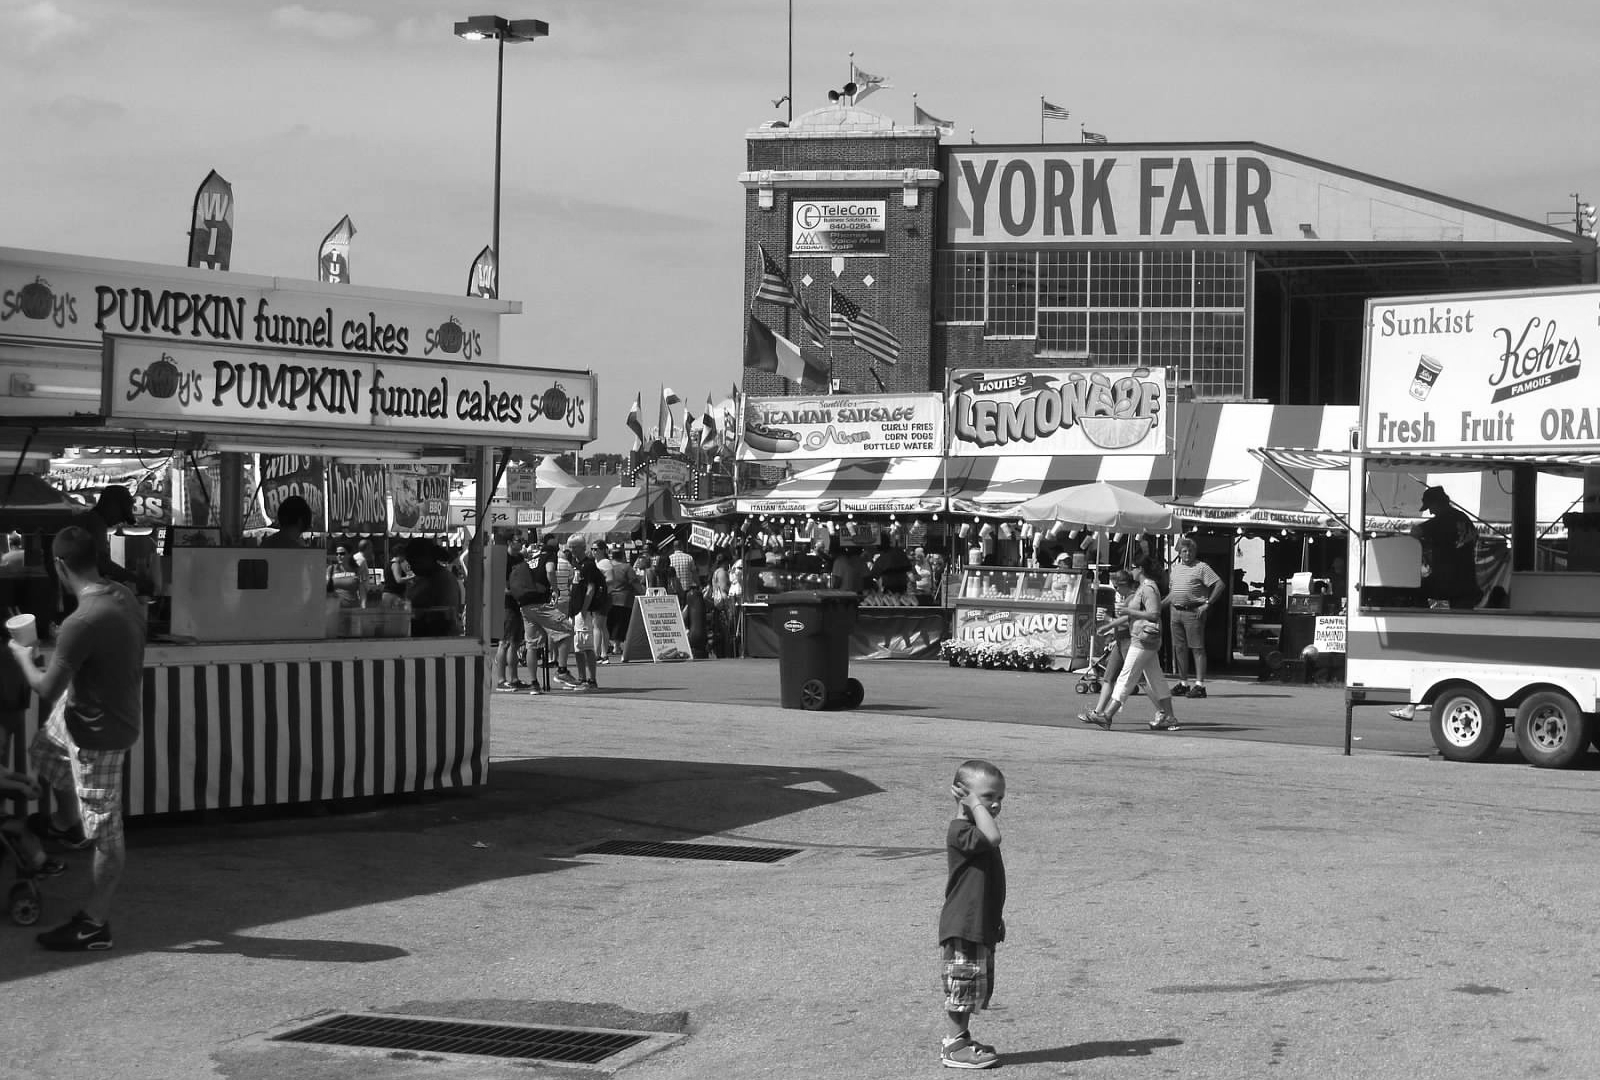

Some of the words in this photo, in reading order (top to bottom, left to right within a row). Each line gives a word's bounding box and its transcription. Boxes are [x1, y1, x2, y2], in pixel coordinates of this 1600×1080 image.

[960, 158, 1117, 236] YORK
[1140, 157, 1273, 236] FAIR
[821, 205, 877, 216] TeleCom
[95, 285, 247, 340] PUMPKIN
[253, 298, 334, 348] funnel
[341, 312, 409, 355] cakes
[1381, 308, 1475, 337] Sunkist
[1489, 317, 1582, 386] Kohrs
[212, 360, 362, 414] PUMPKIN
[369, 369, 449, 419] funnel
[456, 380, 523, 424] cakes
[979, 375, 1027, 392] LOUIE'S
[1511, 376, 1552, 396] FAMOUS
[763, 408, 834, 425] ITALIAN
[837, 405, 916, 423] SAUSAGE
[955, 376, 1161, 448] LEMONADE
[881, 423, 908, 431] CURLY
[911, 423, 934, 431] FRIES
[1378, 411, 1436, 442] Fresh
[1461, 410, 1515, 441] Fruit
[863, 442, 901, 451] BOTTLED
[904, 442, 934, 450] WATER
[885, 433, 908, 441] CORN
[911, 432, 934, 440] DOGS
[460, 508, 509, 522] Pza
[869, 503, 915, 511] CHEESESTEAK
[964, 614, 1068, 643] LEMONADE
